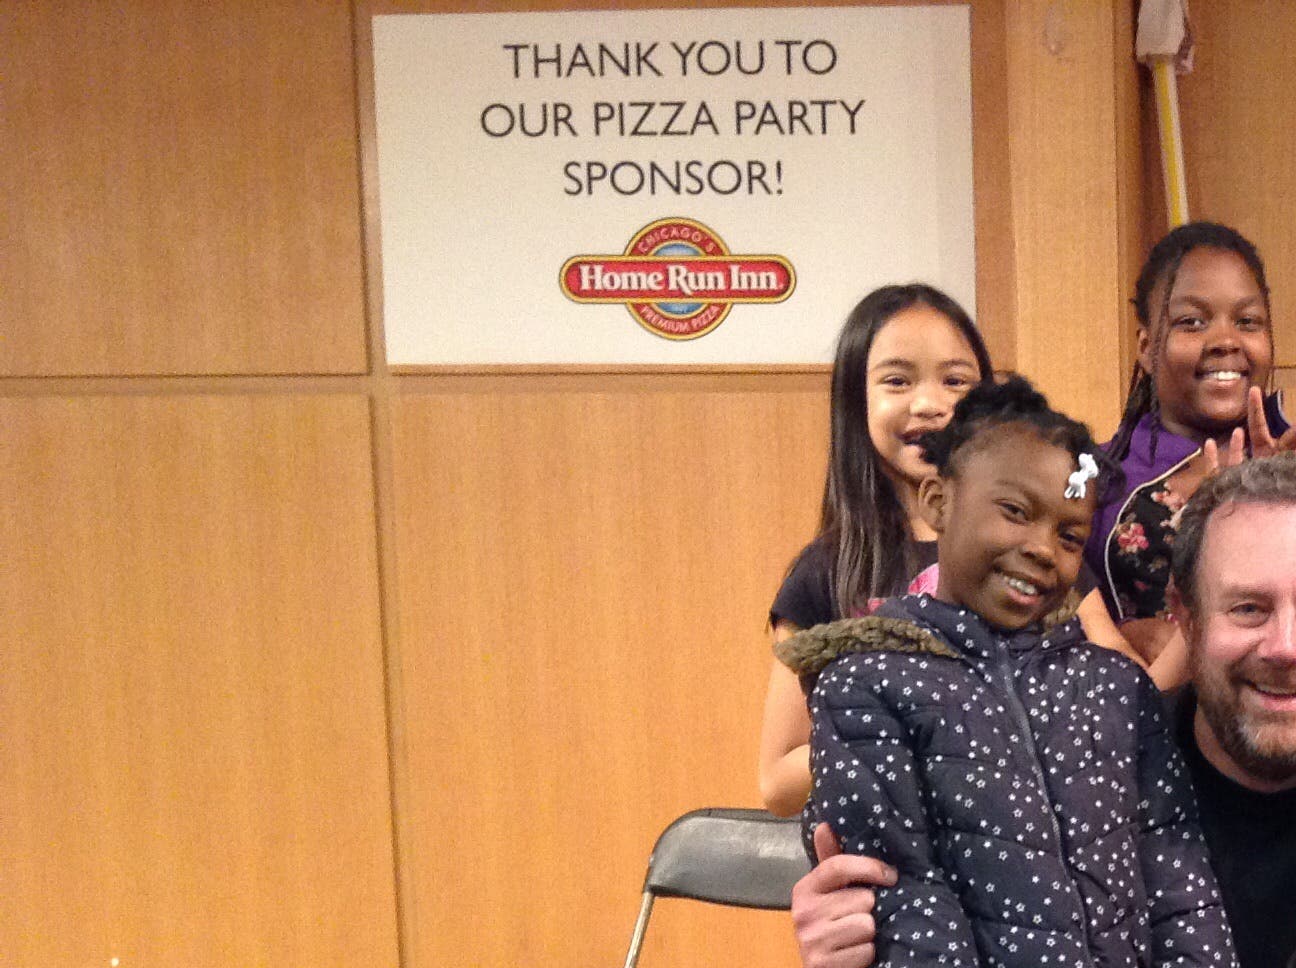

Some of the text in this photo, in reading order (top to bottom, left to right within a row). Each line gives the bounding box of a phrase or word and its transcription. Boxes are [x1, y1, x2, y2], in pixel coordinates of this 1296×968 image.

[503, 40, 838, 79] THANK YOU TO
[480, 100, 866, 138] OUR PIZZA PARTY
[563, 160, 783, 197] SPONSOR!
[637, 226, 717, 254] CHICAGO'S
[579, 264, 779, 296] Home Run Inn
[640, 304, 721, 332] PREMIUM PIZZA
